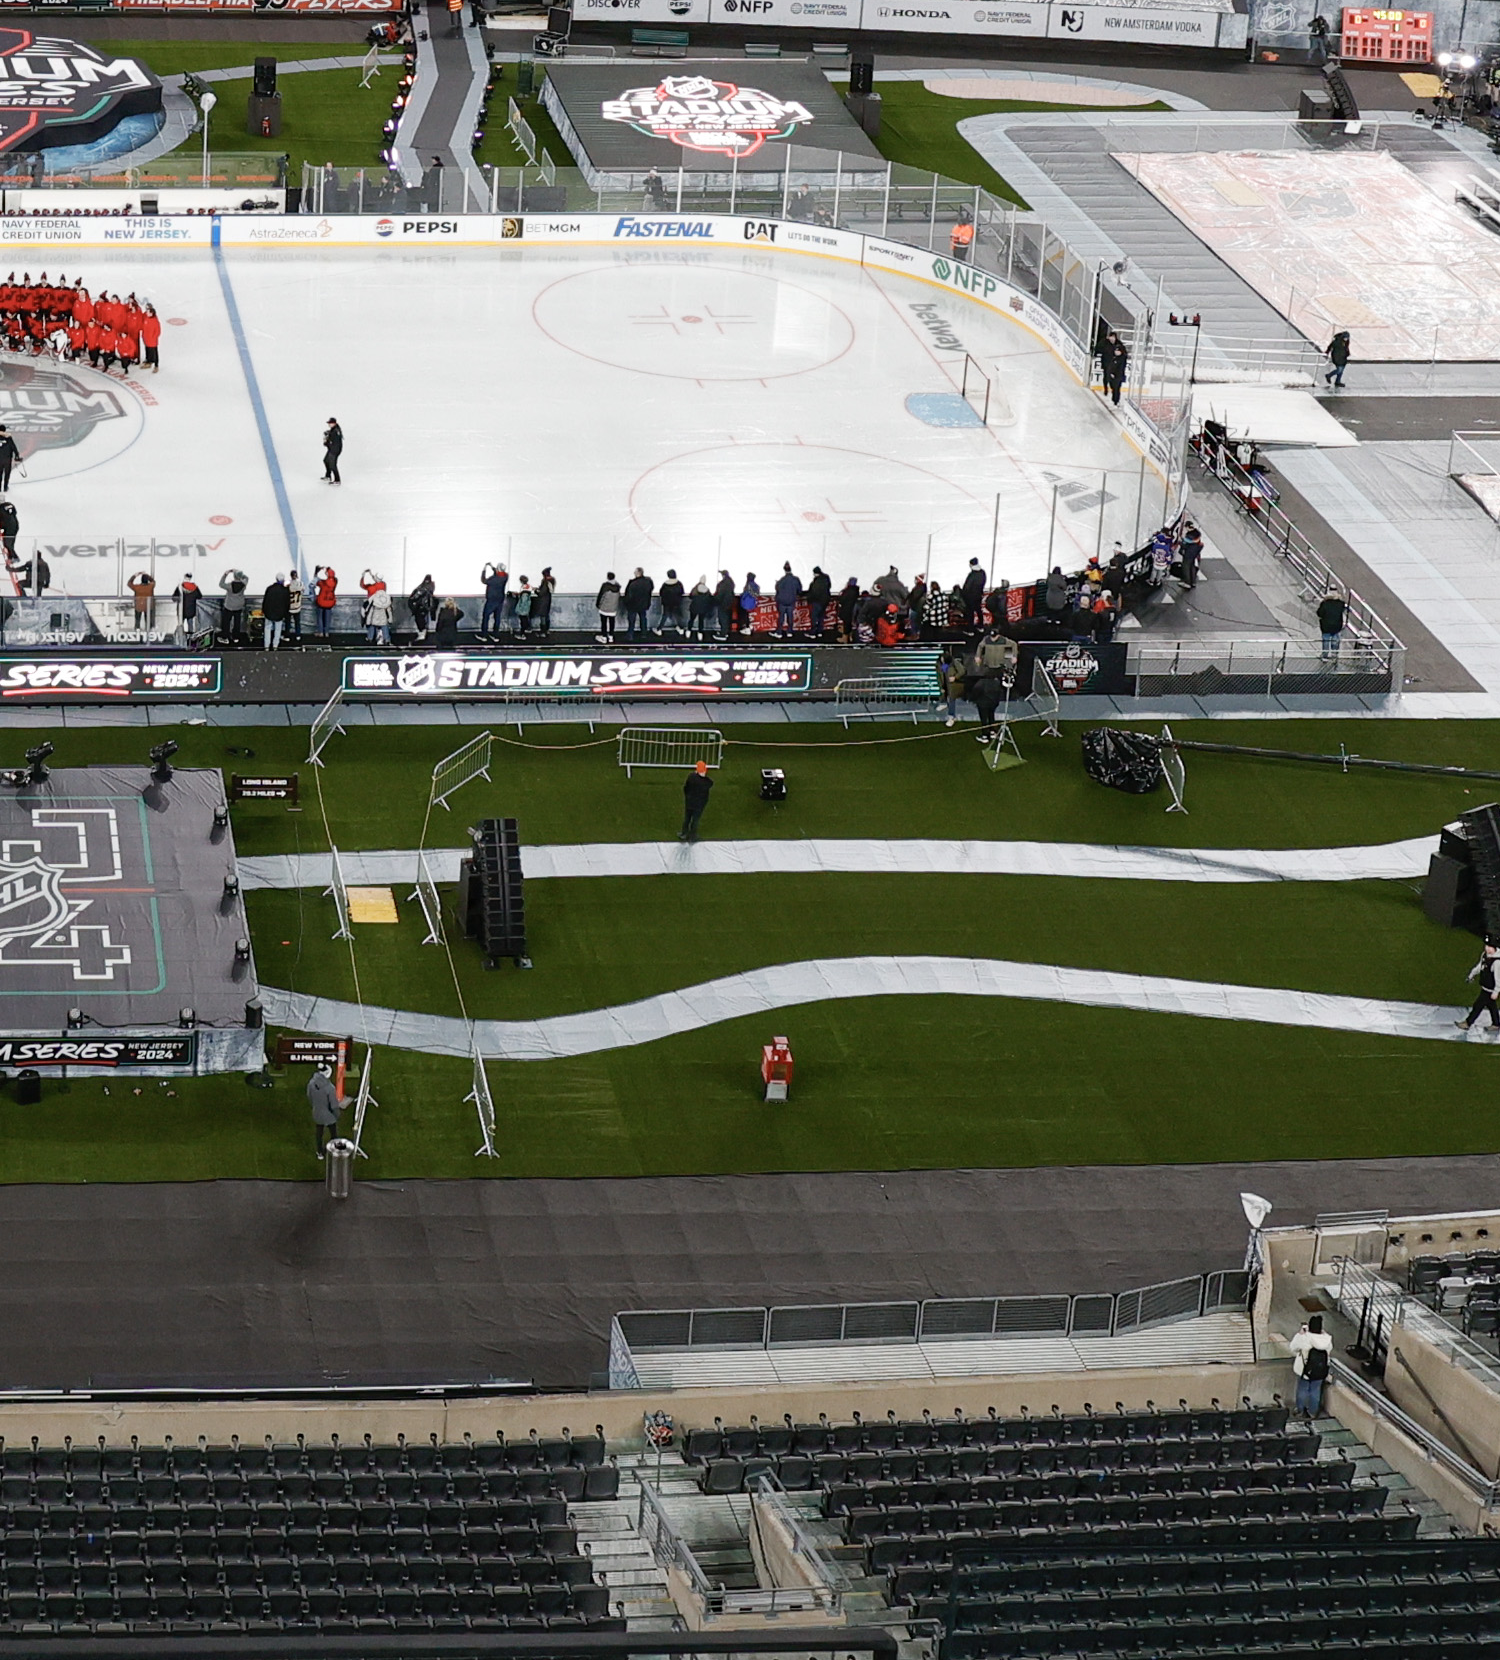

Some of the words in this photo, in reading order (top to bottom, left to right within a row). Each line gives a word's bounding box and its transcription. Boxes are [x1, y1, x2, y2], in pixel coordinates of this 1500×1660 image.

[740, 0, 774, 15] NFP
[892, 9, 952, 19] HONDA
[2, 219, 30, 229] NAVY
[33, 219, 82, 229] FEDERAL
[124, 218, 150, 228] THIS
[153, 218, 172, 228] IS
[402, 222, 458, 234] PEPSI
[525, 222, 581, 233] BETMGM
[613, 216, 716, 238] FASTENAL
[2, 230, 41, 240] CREDIT
[44, 230, 82, 240] UNION
[104, 229, 134, 239] NEW
[249, 228, 318, 239] AstraZeneca
[743, 221, 779, 242] CAT
[954, 265, 997, 297] NFP
[909, 302, 967, 353] betway
[44, 542, 207, 559] verizon
[0, 663, 140, 687] SERIES
[152, 675, 201, 688] 2024
[12, 1043, 126, 1061] SERIES
[150, 1042, 184, 1050] JERSEY
[137, 1050, 174, 1060] 2024
